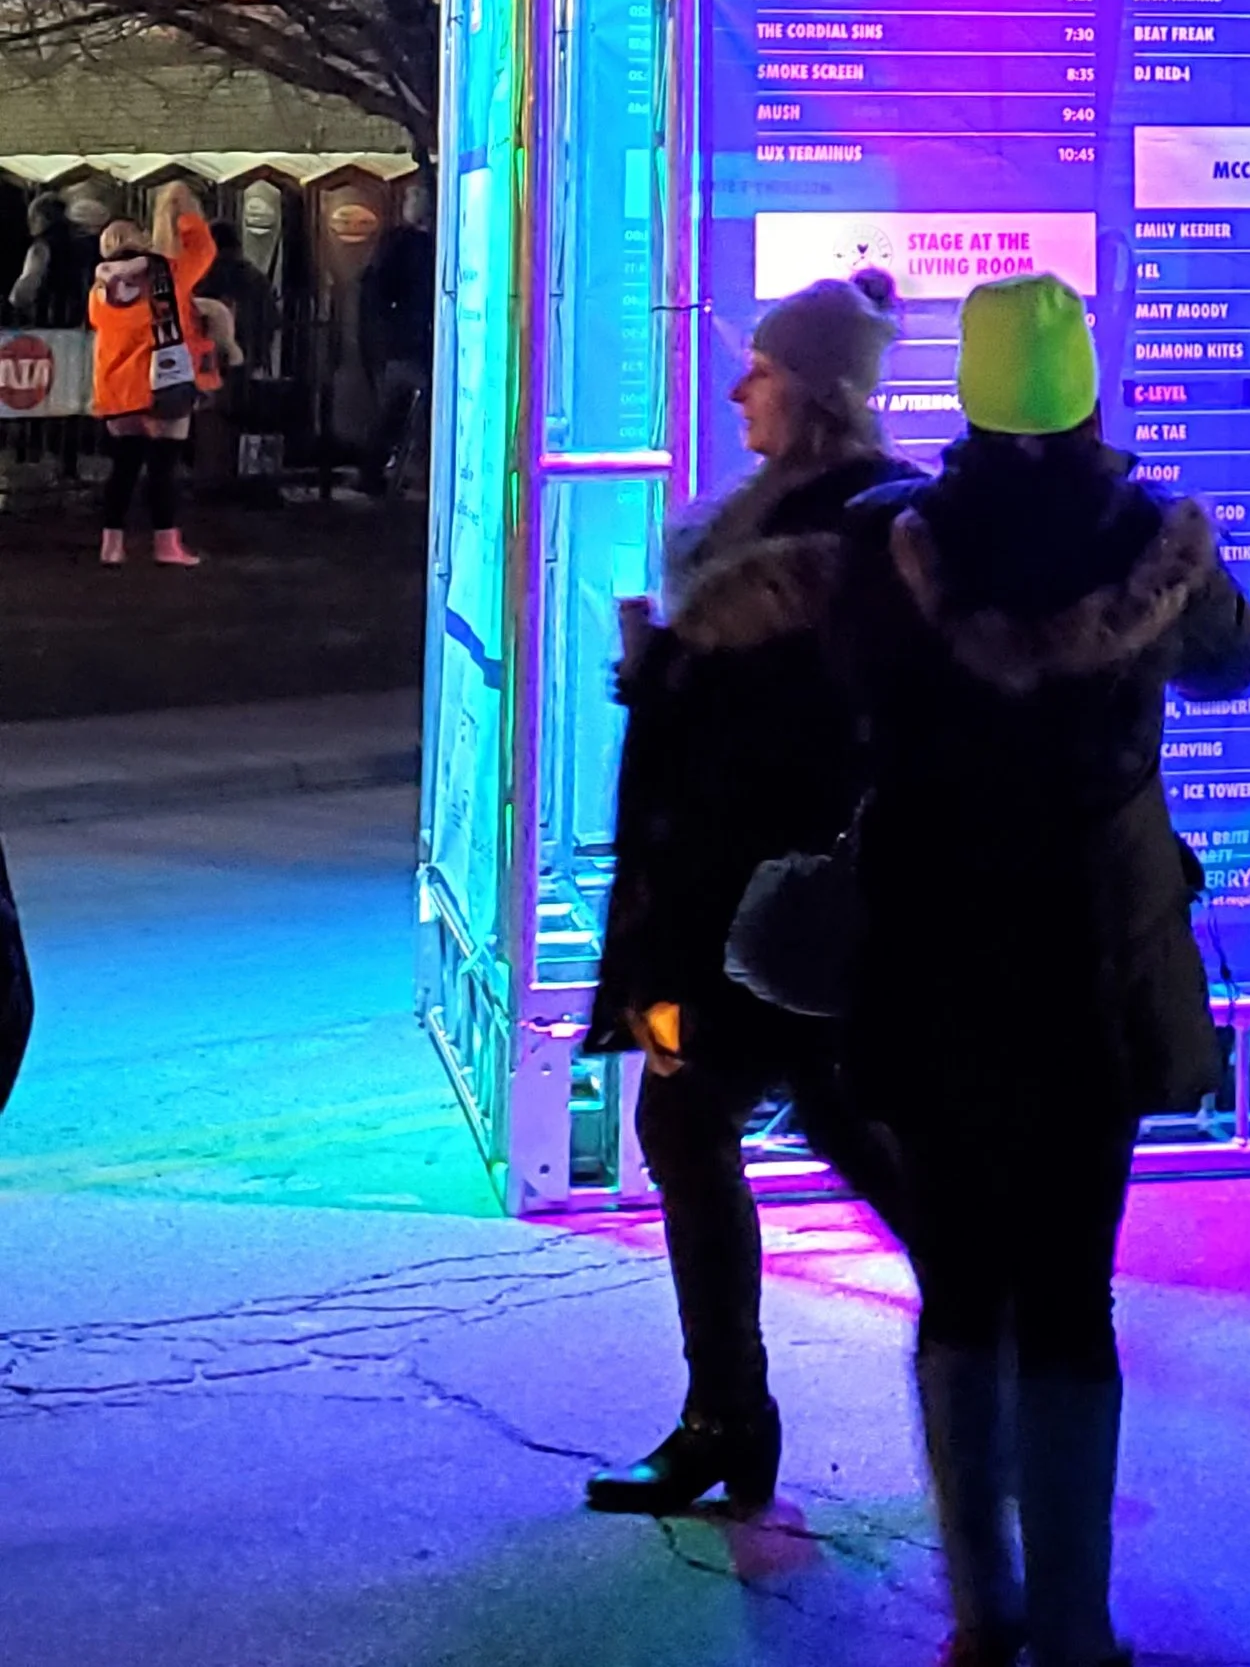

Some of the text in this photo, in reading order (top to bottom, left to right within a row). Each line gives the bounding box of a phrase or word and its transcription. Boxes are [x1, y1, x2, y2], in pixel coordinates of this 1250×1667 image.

[757, 24, 883, 40] THE CORDIAL SINS
[1064, 27, 1094, 42] 7:30
[1134, 26, 1215, 42] BEAT FREAK
[757, 64, 864, 80] SMOKE SCREEN
[1067, 67, 1094, 82] 8:35
[1134, 67, 1151, 81] DJ
[757, 105, 800, 121] MUSH
[1062, 108, 1095, 122] 9:40
[757, 146, 862, 161] LUX TERMINUS
[1058, 147, 1095, 162] 10:45
[1135, 223, 1231, 238] EMILY KEENER
[908, 232, 1030, 251] STAGE AT THE
[908, 257, 1034, 276] LIVING ROOM
[1135, 303, 1228, 320] MATT MOODY
[1135, 343, 1243, 359] DIAMOND KITES
[1134, 386, 1187, 401] C-LEVEL
[866, 394, 962, 411] AY AFTERNOO
[1136, 424, 1187, 440] MC TAE
[1137, 465, 1180, 481] ALOOF
[1215, 506, 1246, 521] GOD
[1161, 741, 1223, 758] CARVING
[1183, 783, 1205, 799] ICE
[1180, 832, 1208, 847] IAL
